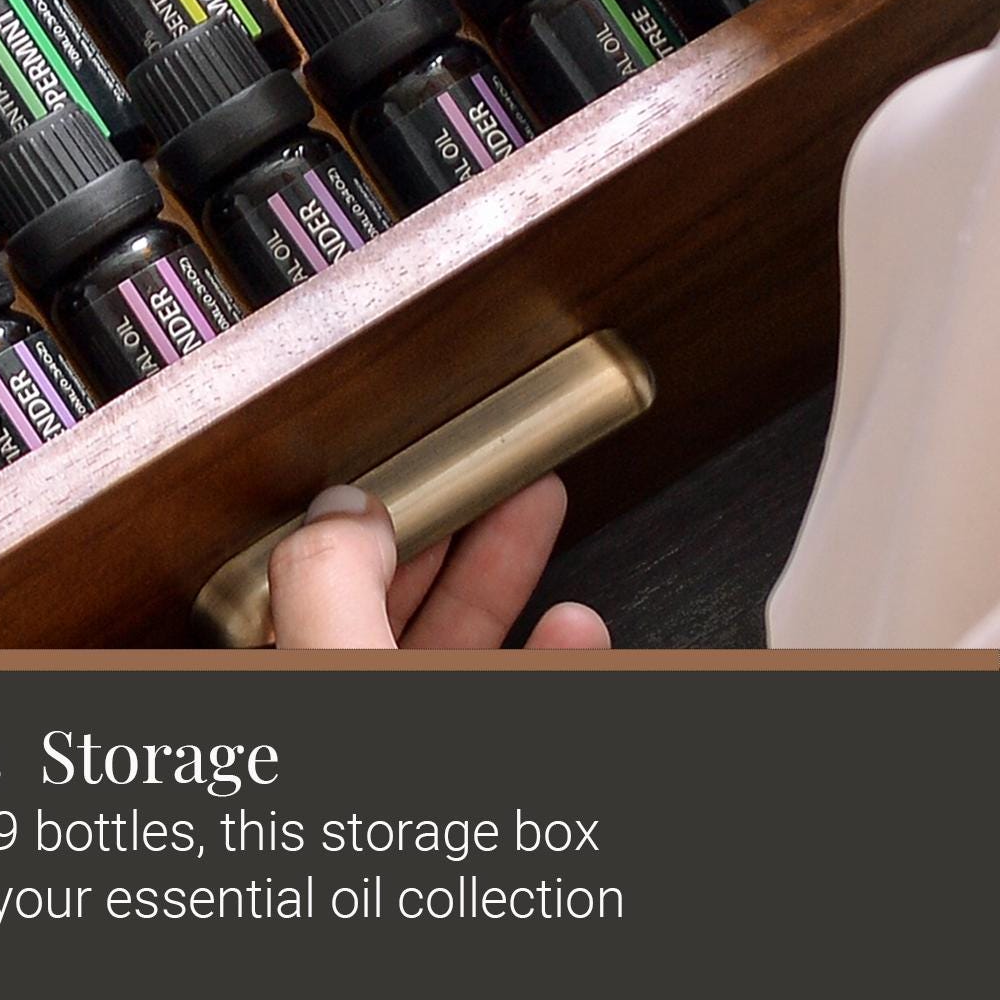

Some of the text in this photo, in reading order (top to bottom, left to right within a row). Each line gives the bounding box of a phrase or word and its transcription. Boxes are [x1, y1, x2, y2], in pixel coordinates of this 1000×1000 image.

[596, 22, 621, 51] OIL
[631, 5, 674, 59] TREE
[434, 128, 459, 158] OIL
[468, 101, 514, 162] NDER
[299, 198, 347, 264] NDER
[327, 167, 378, 240] 0ML(0.34OZ)
[266, 229, 291, 259] OIL
[150, 286, 202, 354] NDER
[179, 256, 230, 331] 0ML(0.34OZ)
[116, 315, 141, 346] OIL
[35, 341, 86, 418] 0ML(0.34OZ)
